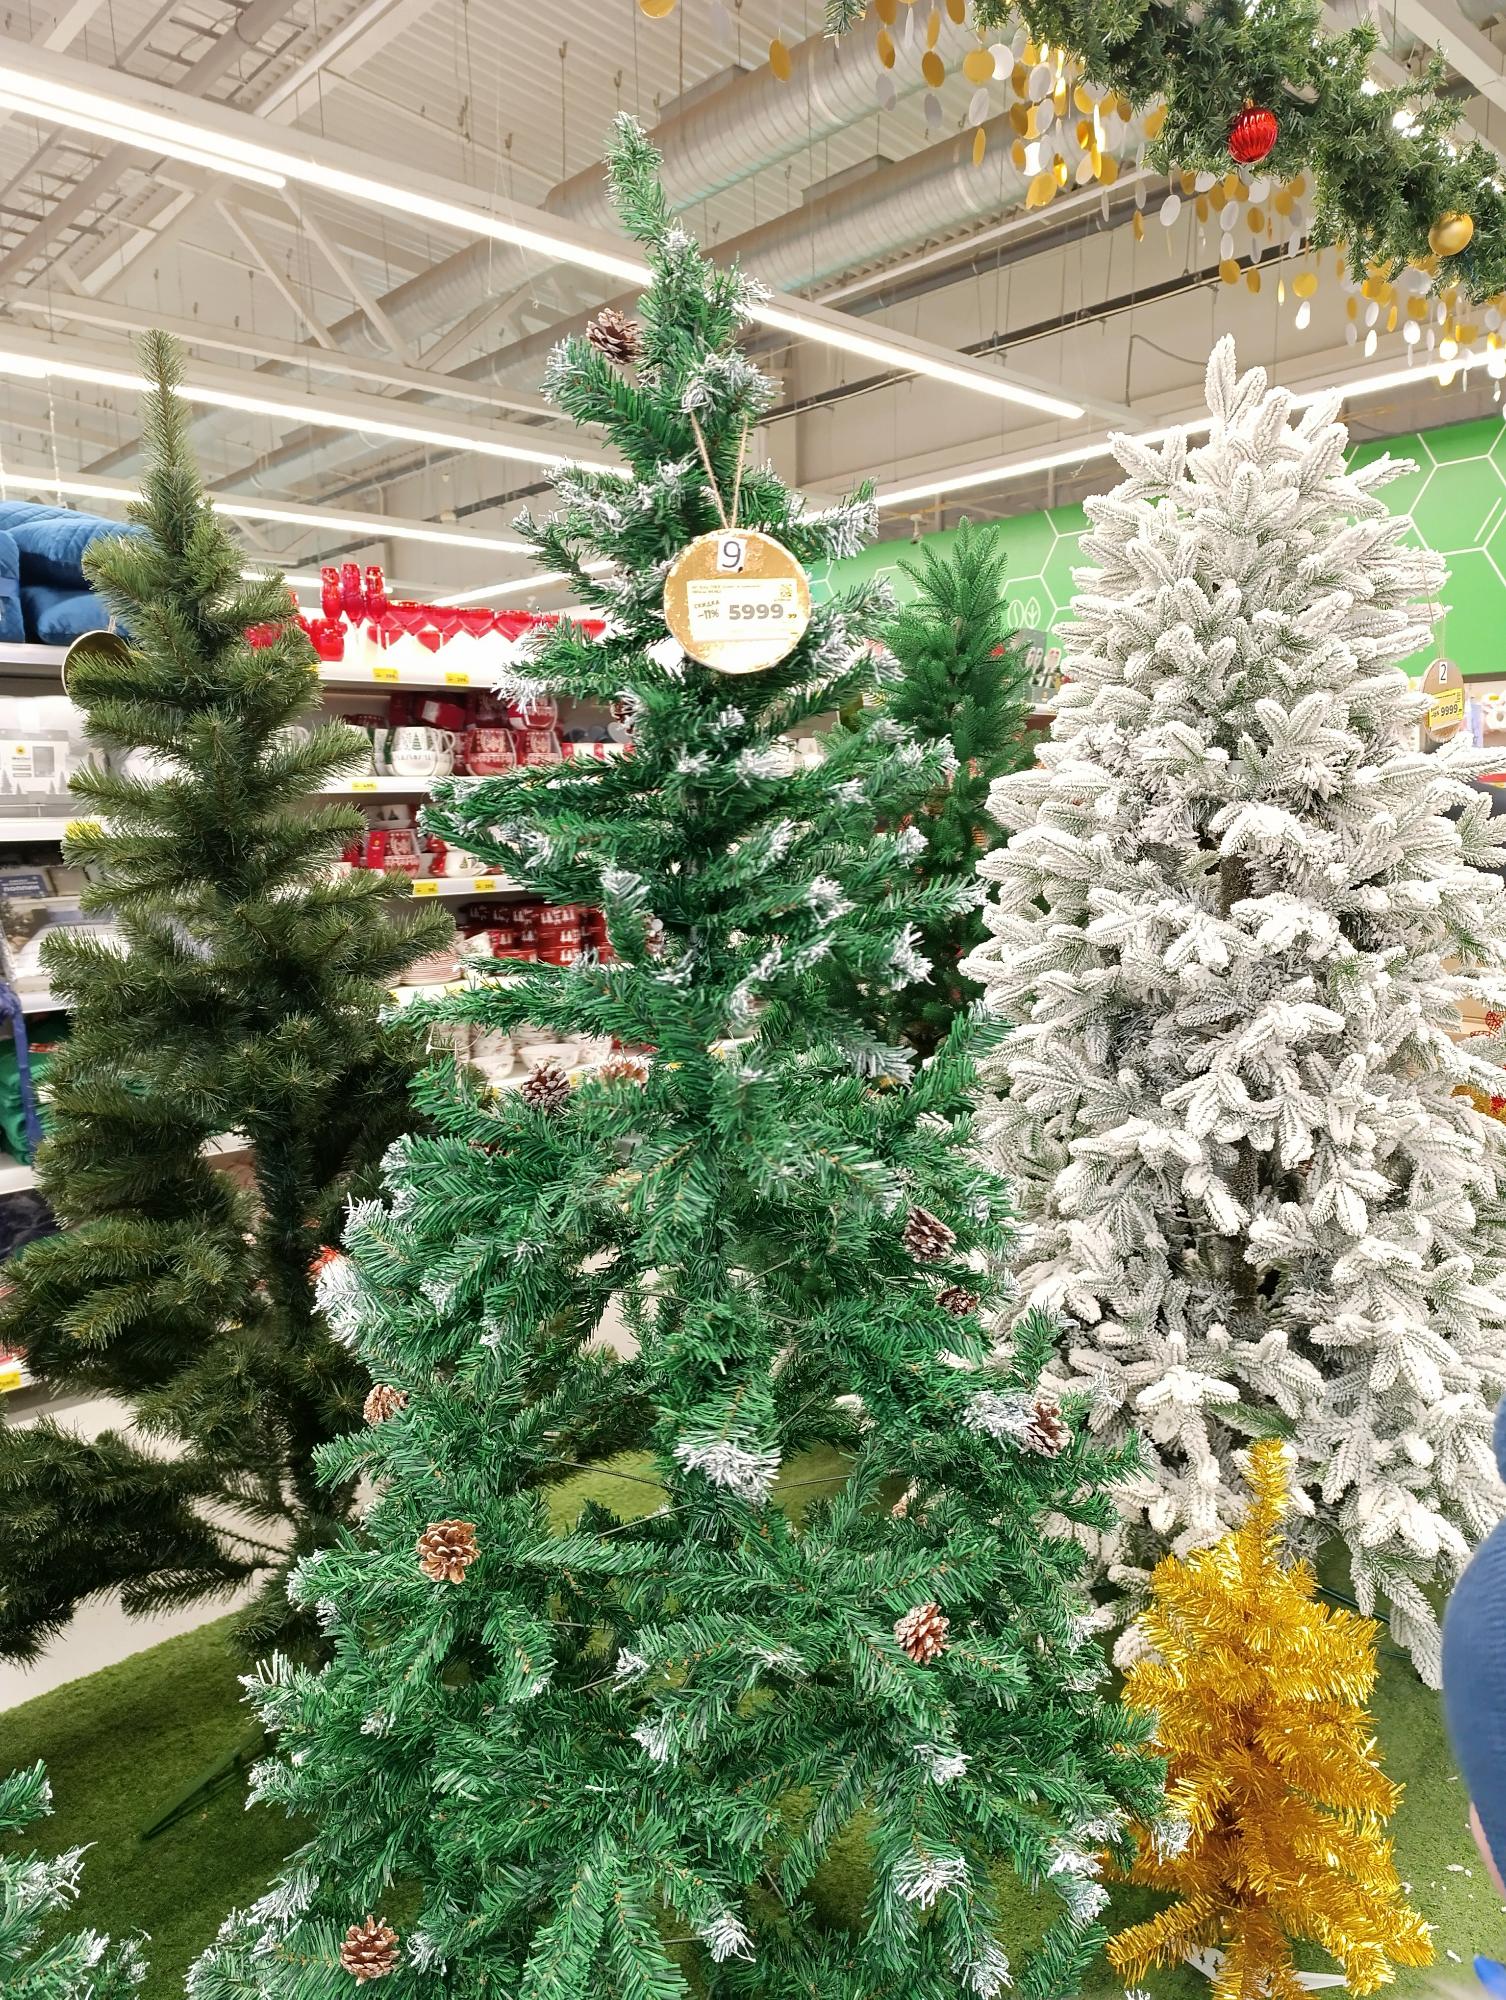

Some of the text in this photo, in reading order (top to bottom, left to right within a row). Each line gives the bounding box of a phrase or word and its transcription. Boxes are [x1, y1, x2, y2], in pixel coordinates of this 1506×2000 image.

[722, 541, 741, 568] 9
[729, 603, 784, 620] 5999
[1440, 664, 1447, 681] 2
[1441, 703, 1458, 717] 9999
